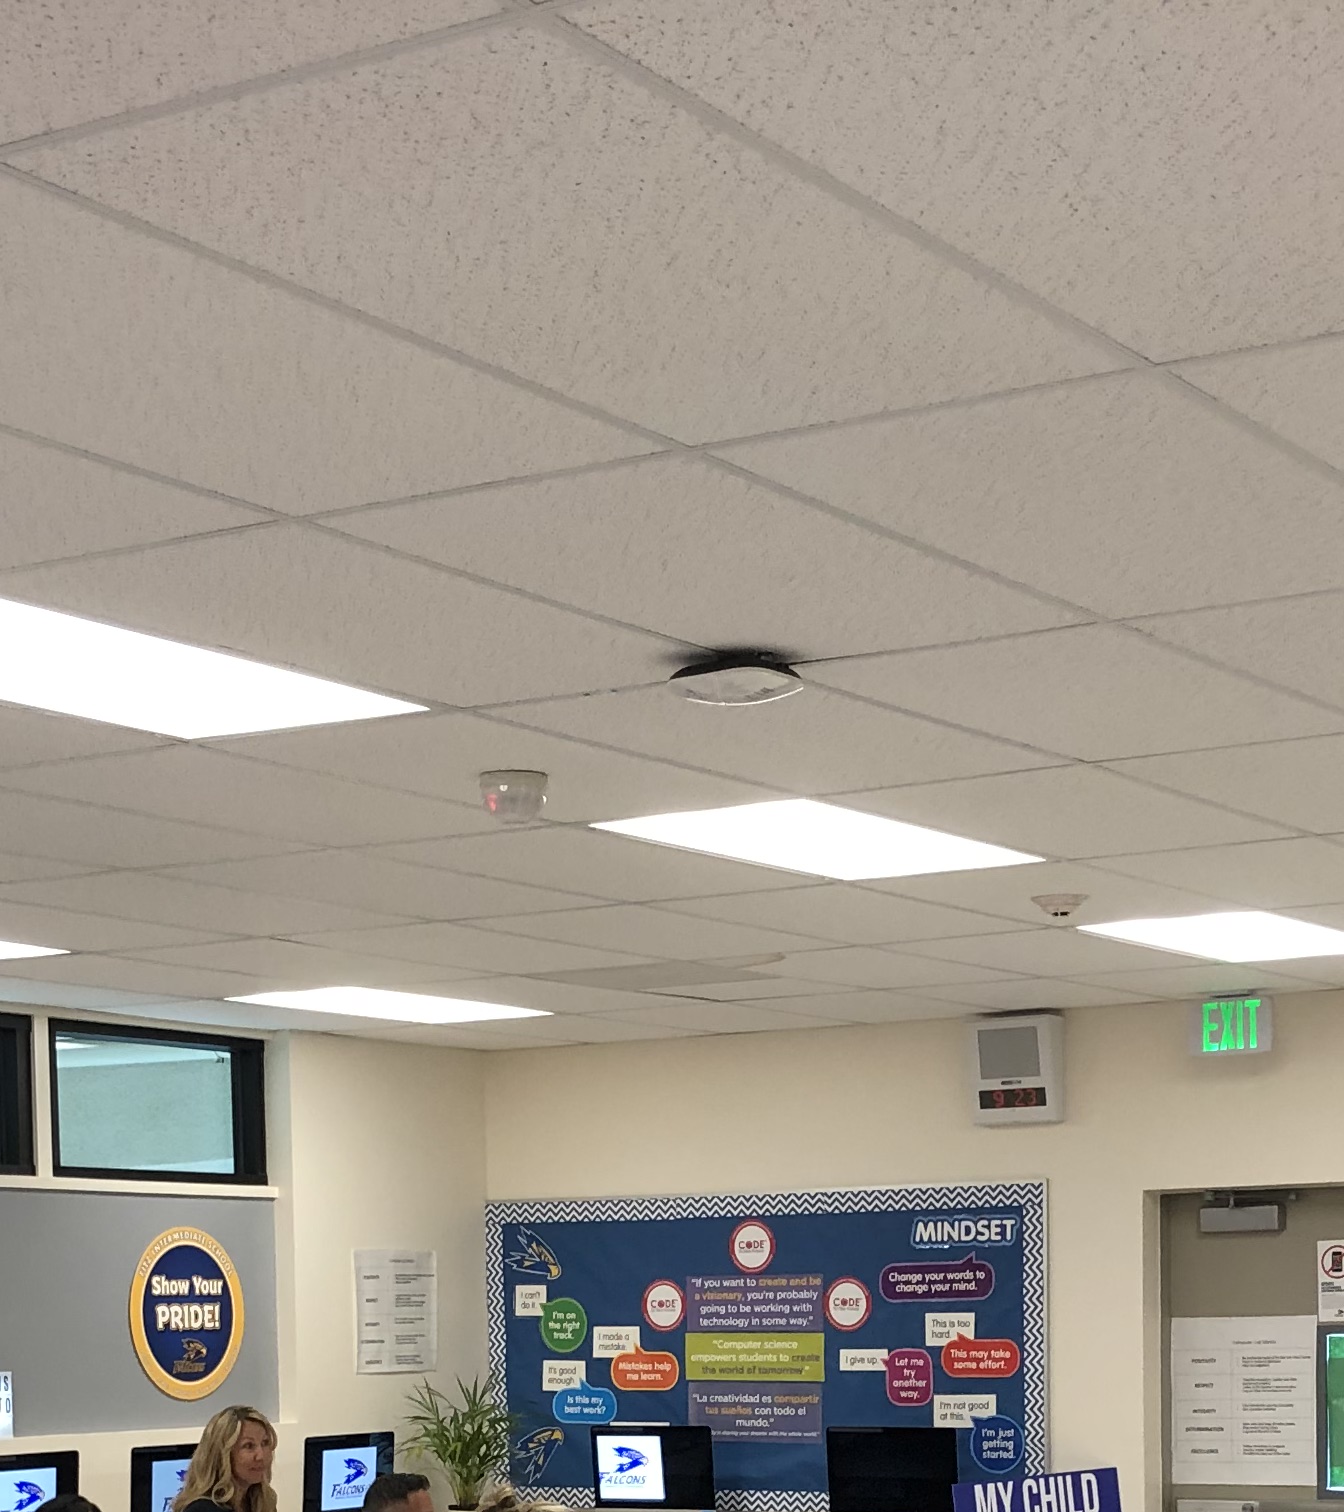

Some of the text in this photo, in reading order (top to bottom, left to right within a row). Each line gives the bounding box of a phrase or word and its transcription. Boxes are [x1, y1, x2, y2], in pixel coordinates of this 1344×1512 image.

[1202, 999, 1261, 1052] EXIT
[914, 1219, 1016, 1242] MINDSET
[738, 1240, 765, 1249] CODE
[888, 1269, 985, 1283] Change your words to
[151, 1275, 223, 1296] Show Your
[704, 1277, 822, 1289] you want to create and be
[896, 1281, 978, 1294] change your mind.
[747, 1291, 774, 1301] you're
[777, 1290, 818, 1301] probably
[699, 1303, 813, 1314] going to be working with
[155, 1302, 221, 1331] PRIDE!
[552, 1311, 576, 1320] I'm on
[548, 1321, 580, 1332] the right
[699, 1316, 750, 1327] technology
[751, 1316, 760, 1325] in
[762, 1317, 787, 1326] some
[932, 1319, 970, 1328] This too
[602, 1332, 623, 1340] made
[763, 1340, 798, 1349] science
[690, 1353, 736, 1363] empowers
[738, 1353, 777, 1362] students
[779, 1353, 789, 1362] to
[950, 1349, 1011, 1360] This may take
[850, 1356, 865, 1366] give
[895, 1358, 908, 1366] Let
[954, 1360, 1007, 1369] some effort.
[559, 1367, 577, 1376] good
[618, 1361, 672, 1372] Mistakes help
[701, 1366, 744, 1375] the world
[640, 1372, 664, 1381] learn.
[904, 1368, 916, 1378] try
[893, 1378, 927, 1387] another
[575, 1395, 604, 1406] this my
[709, 1393, 760, 1403] creatividad
[762, 1395, 772, 1403] es
[564, 1405, 607, 1414] best work?
[754, 1406, 806, 1415] con todo el
[939, 1401, 951, 1410] I'm
[968, 1401, 989, 1411] good
[982, 1428, 1015, 1439] I'm just
[982, 1440, 1014, 1450] getting
[982, 1450, 1016, 1459] started.
[598, 1472, 647, 1485] FALCONS
[331, 1484, 365, 1498] FALCONS
